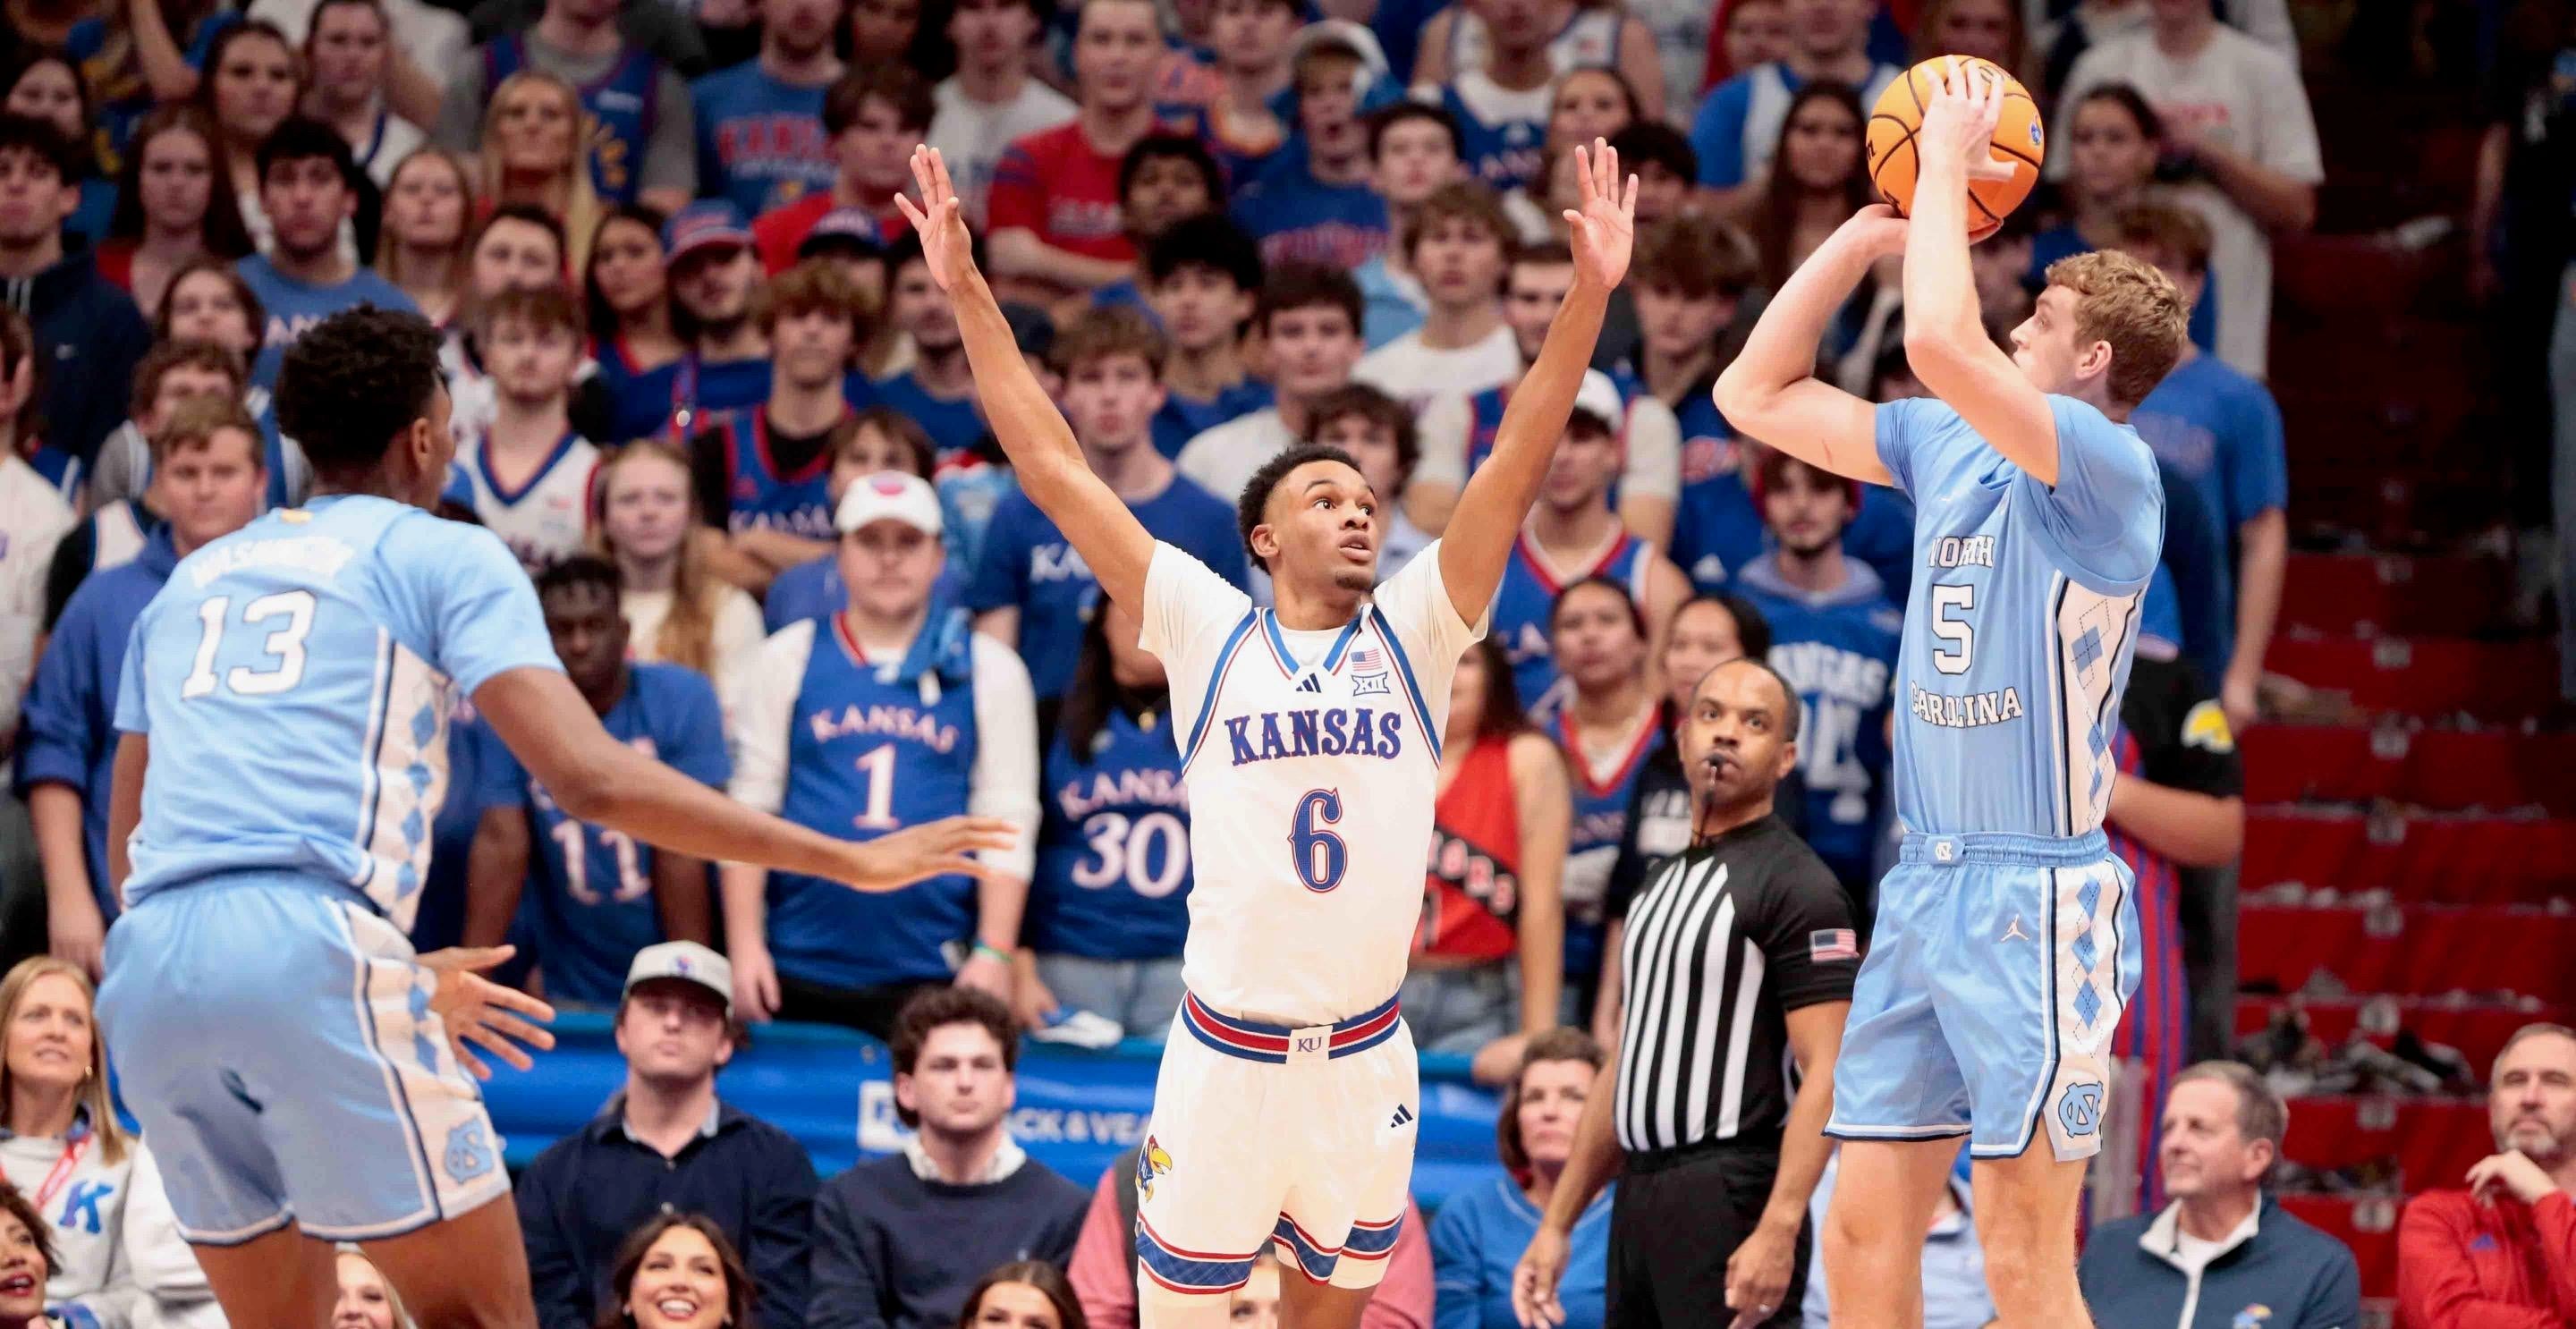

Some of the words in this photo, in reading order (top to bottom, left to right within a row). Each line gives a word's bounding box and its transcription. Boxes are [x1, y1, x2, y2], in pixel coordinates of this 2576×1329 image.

[182, 588, 317, 701] 13
[1932, 583, 1974, 675] 5
[811, 702, 960, 754] KANSAS
[1911, 681, 2022, 728] CAROLINA
[1224, 707, 1402, 766] KANSAS
[853, 743, 902, 830] 1
[1058, 768, 1191, 821] KANSA
[1071, 812, 1191, 898] 30
[1287, 787, 1348, 893] 6
[1296, 1036, 1324, 1053] KU
[58, 1179, 114, 1234] K
